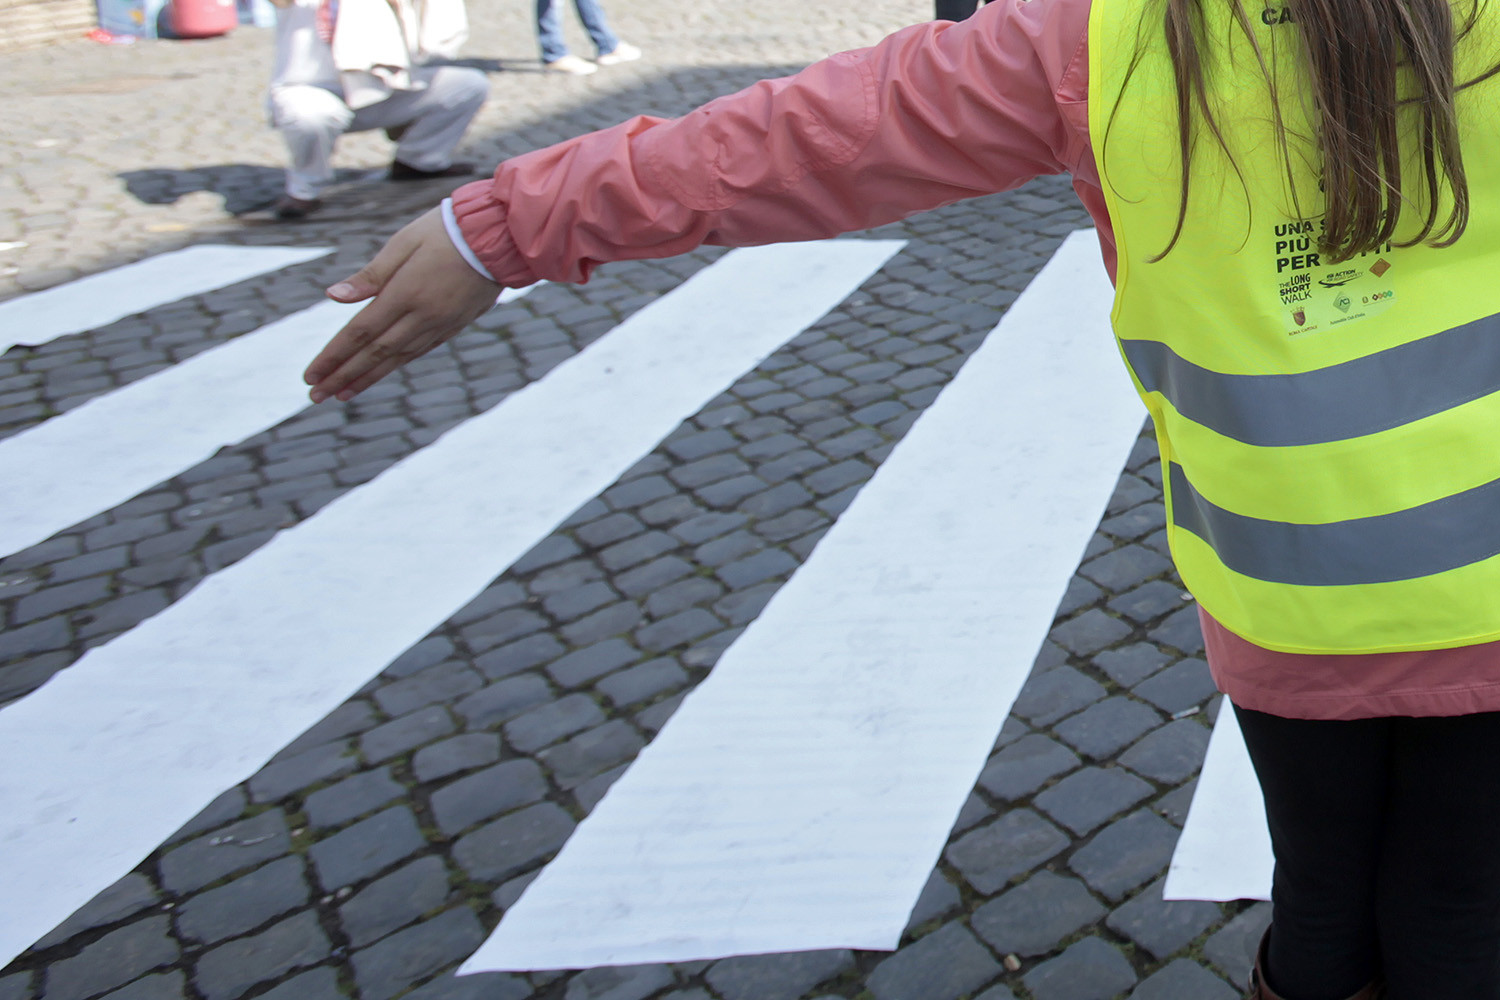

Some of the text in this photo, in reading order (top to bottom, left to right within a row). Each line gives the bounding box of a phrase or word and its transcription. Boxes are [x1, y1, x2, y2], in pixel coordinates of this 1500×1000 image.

[1274, 220, 1314, 237] UNA
[1275, 235, 1310, 255] PIÙ
[1276, 253, 1320, 274] PER
[1290, 272, 1311, 286] LONG
[1279, 282, 1311, 297] SHORT
[1280, 289, 1313, 305] WALK
